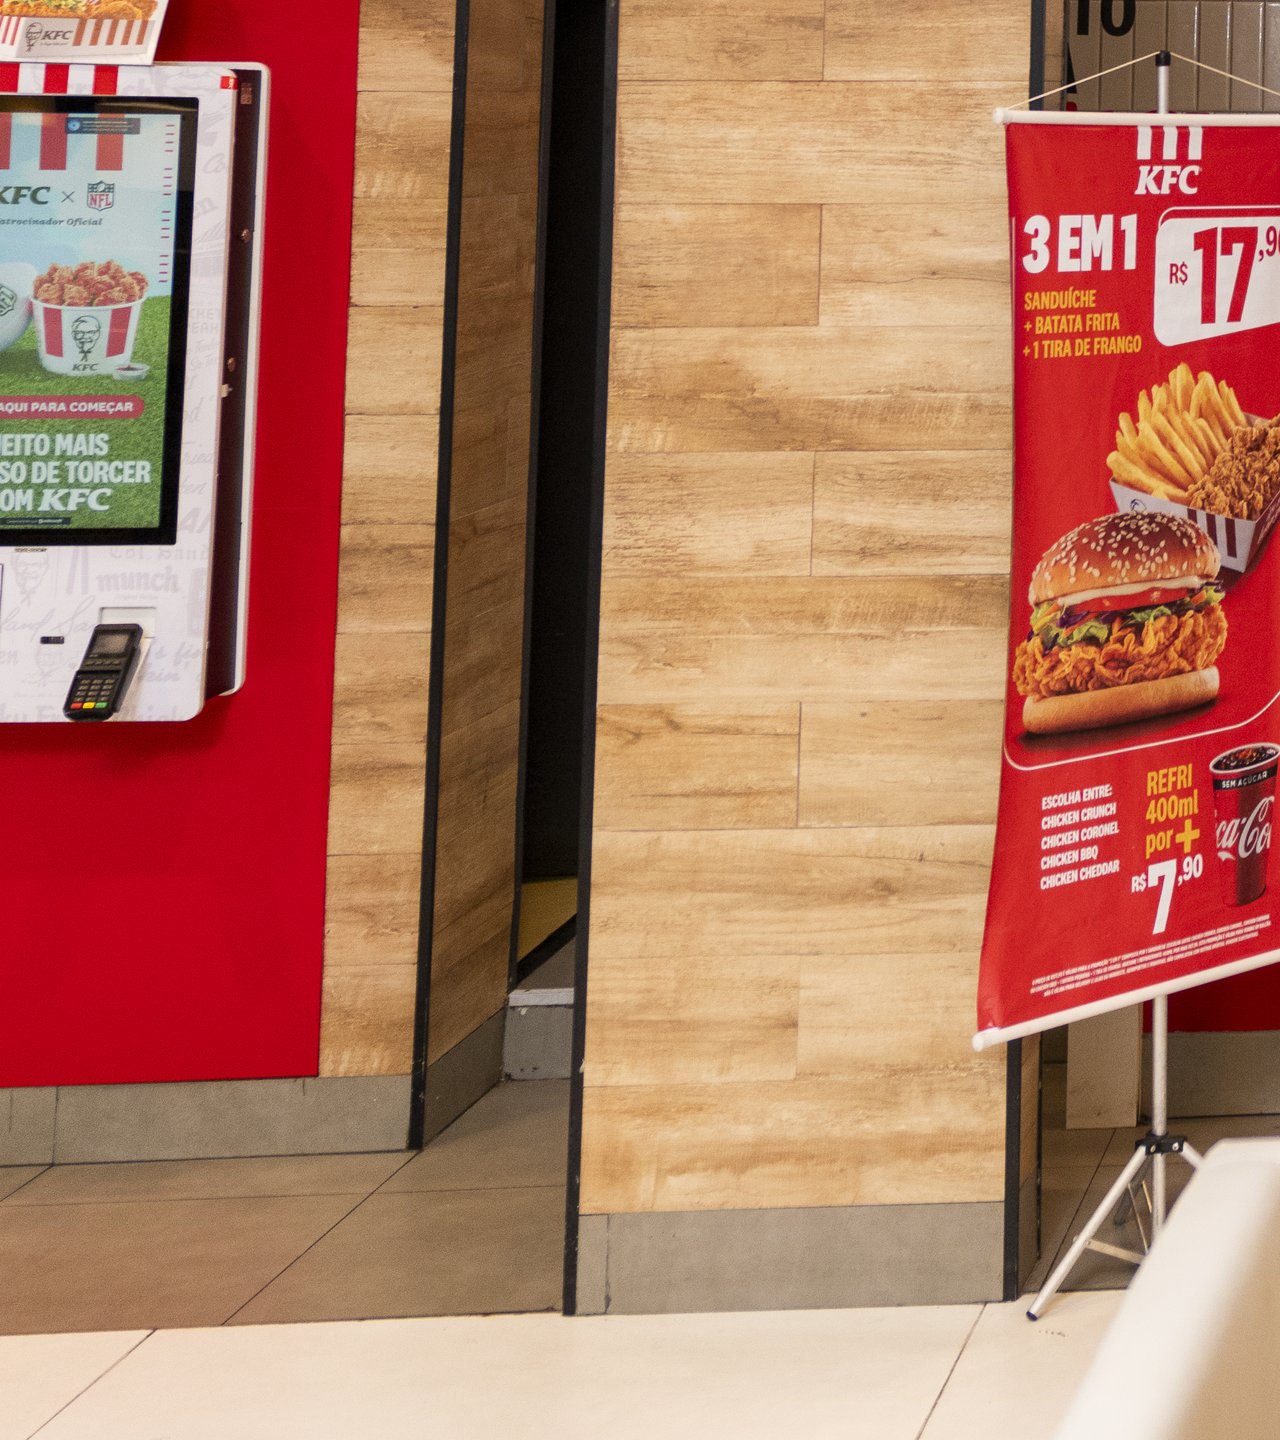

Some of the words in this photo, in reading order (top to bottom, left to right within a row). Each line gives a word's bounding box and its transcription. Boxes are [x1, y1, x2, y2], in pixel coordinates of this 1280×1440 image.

[1135, 165, 1200, 195] KFC
[90, 193, 111, 208] NFL
[1023, 215, 1050, 274] 3
[1058, 214, 1113, 272] EM
[1121, 214, 1137, 270] 1
[1025, 286, 1096, 310] SANDUÍCHE
[1035, 315, 1084, 334] BATATA
[1086, 312, 1120, 332] FRITA
[31, 402, 66, 412] PARA
[69, 402, 133, 413] COMEÇAR
[55, 433, 109, 456] MAIS
[31, 461, 59, 484] DE
[65, 461, 150, 484] TORCER
[39, 488, 113, 511] KFC
[1147, 763, 1192, 796] REFRI
[1042, 788, 1081, 810] ESCOLHA
[1083, 784, 1112, 803] ENTRE:
[1146, 789, 1199, 824] 400ml
[1040, 869, 1078, 890] CHICKEN
[1080, 859, 1120, 881] CHEDDAR
[1148, 853, 1203, 935] 7,90
